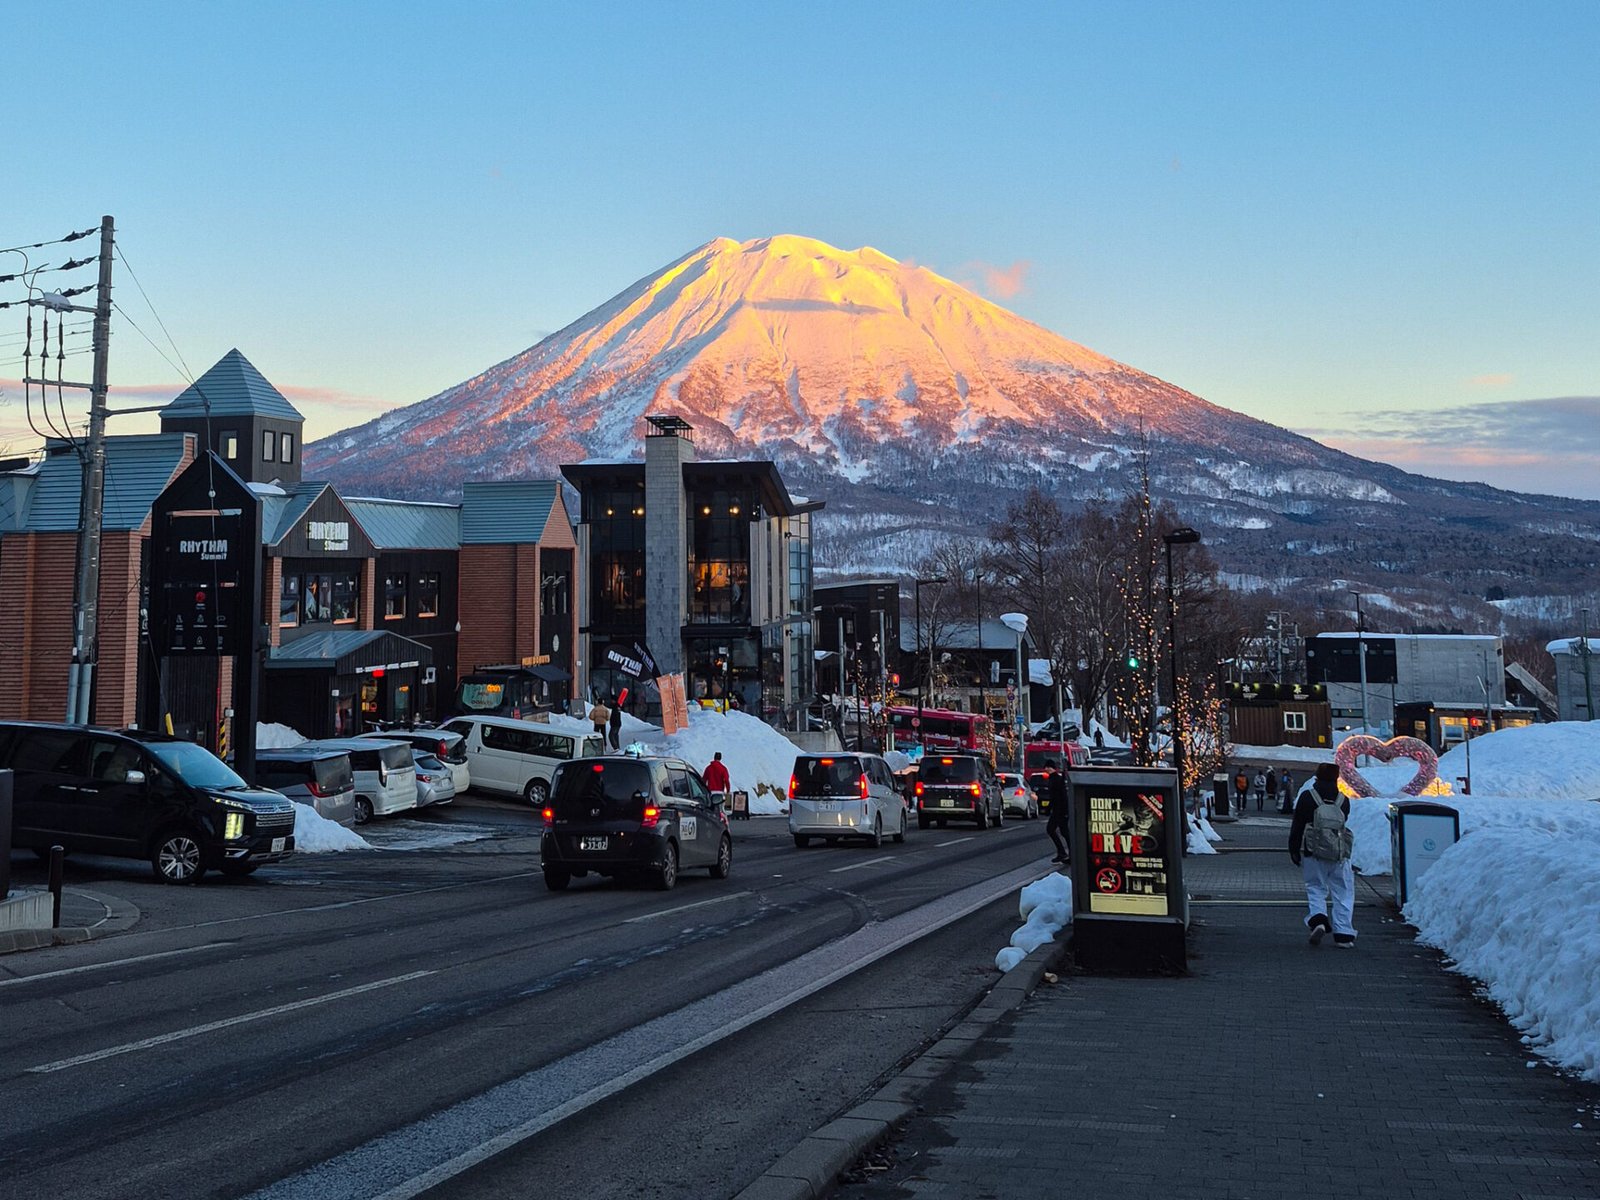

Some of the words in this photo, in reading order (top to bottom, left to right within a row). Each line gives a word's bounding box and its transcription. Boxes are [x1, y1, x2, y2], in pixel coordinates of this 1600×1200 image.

[180, 540, 228, 553] RHYTHM
[607, 650, 643, 672] RHYTHM
[1090, 798, 1122, 810] DON'T
[1091, 810, 1125, 822] DRINK
[1091, 822, 1113, 834] AND
[1092, 834, 1143, 854] DRIVE
